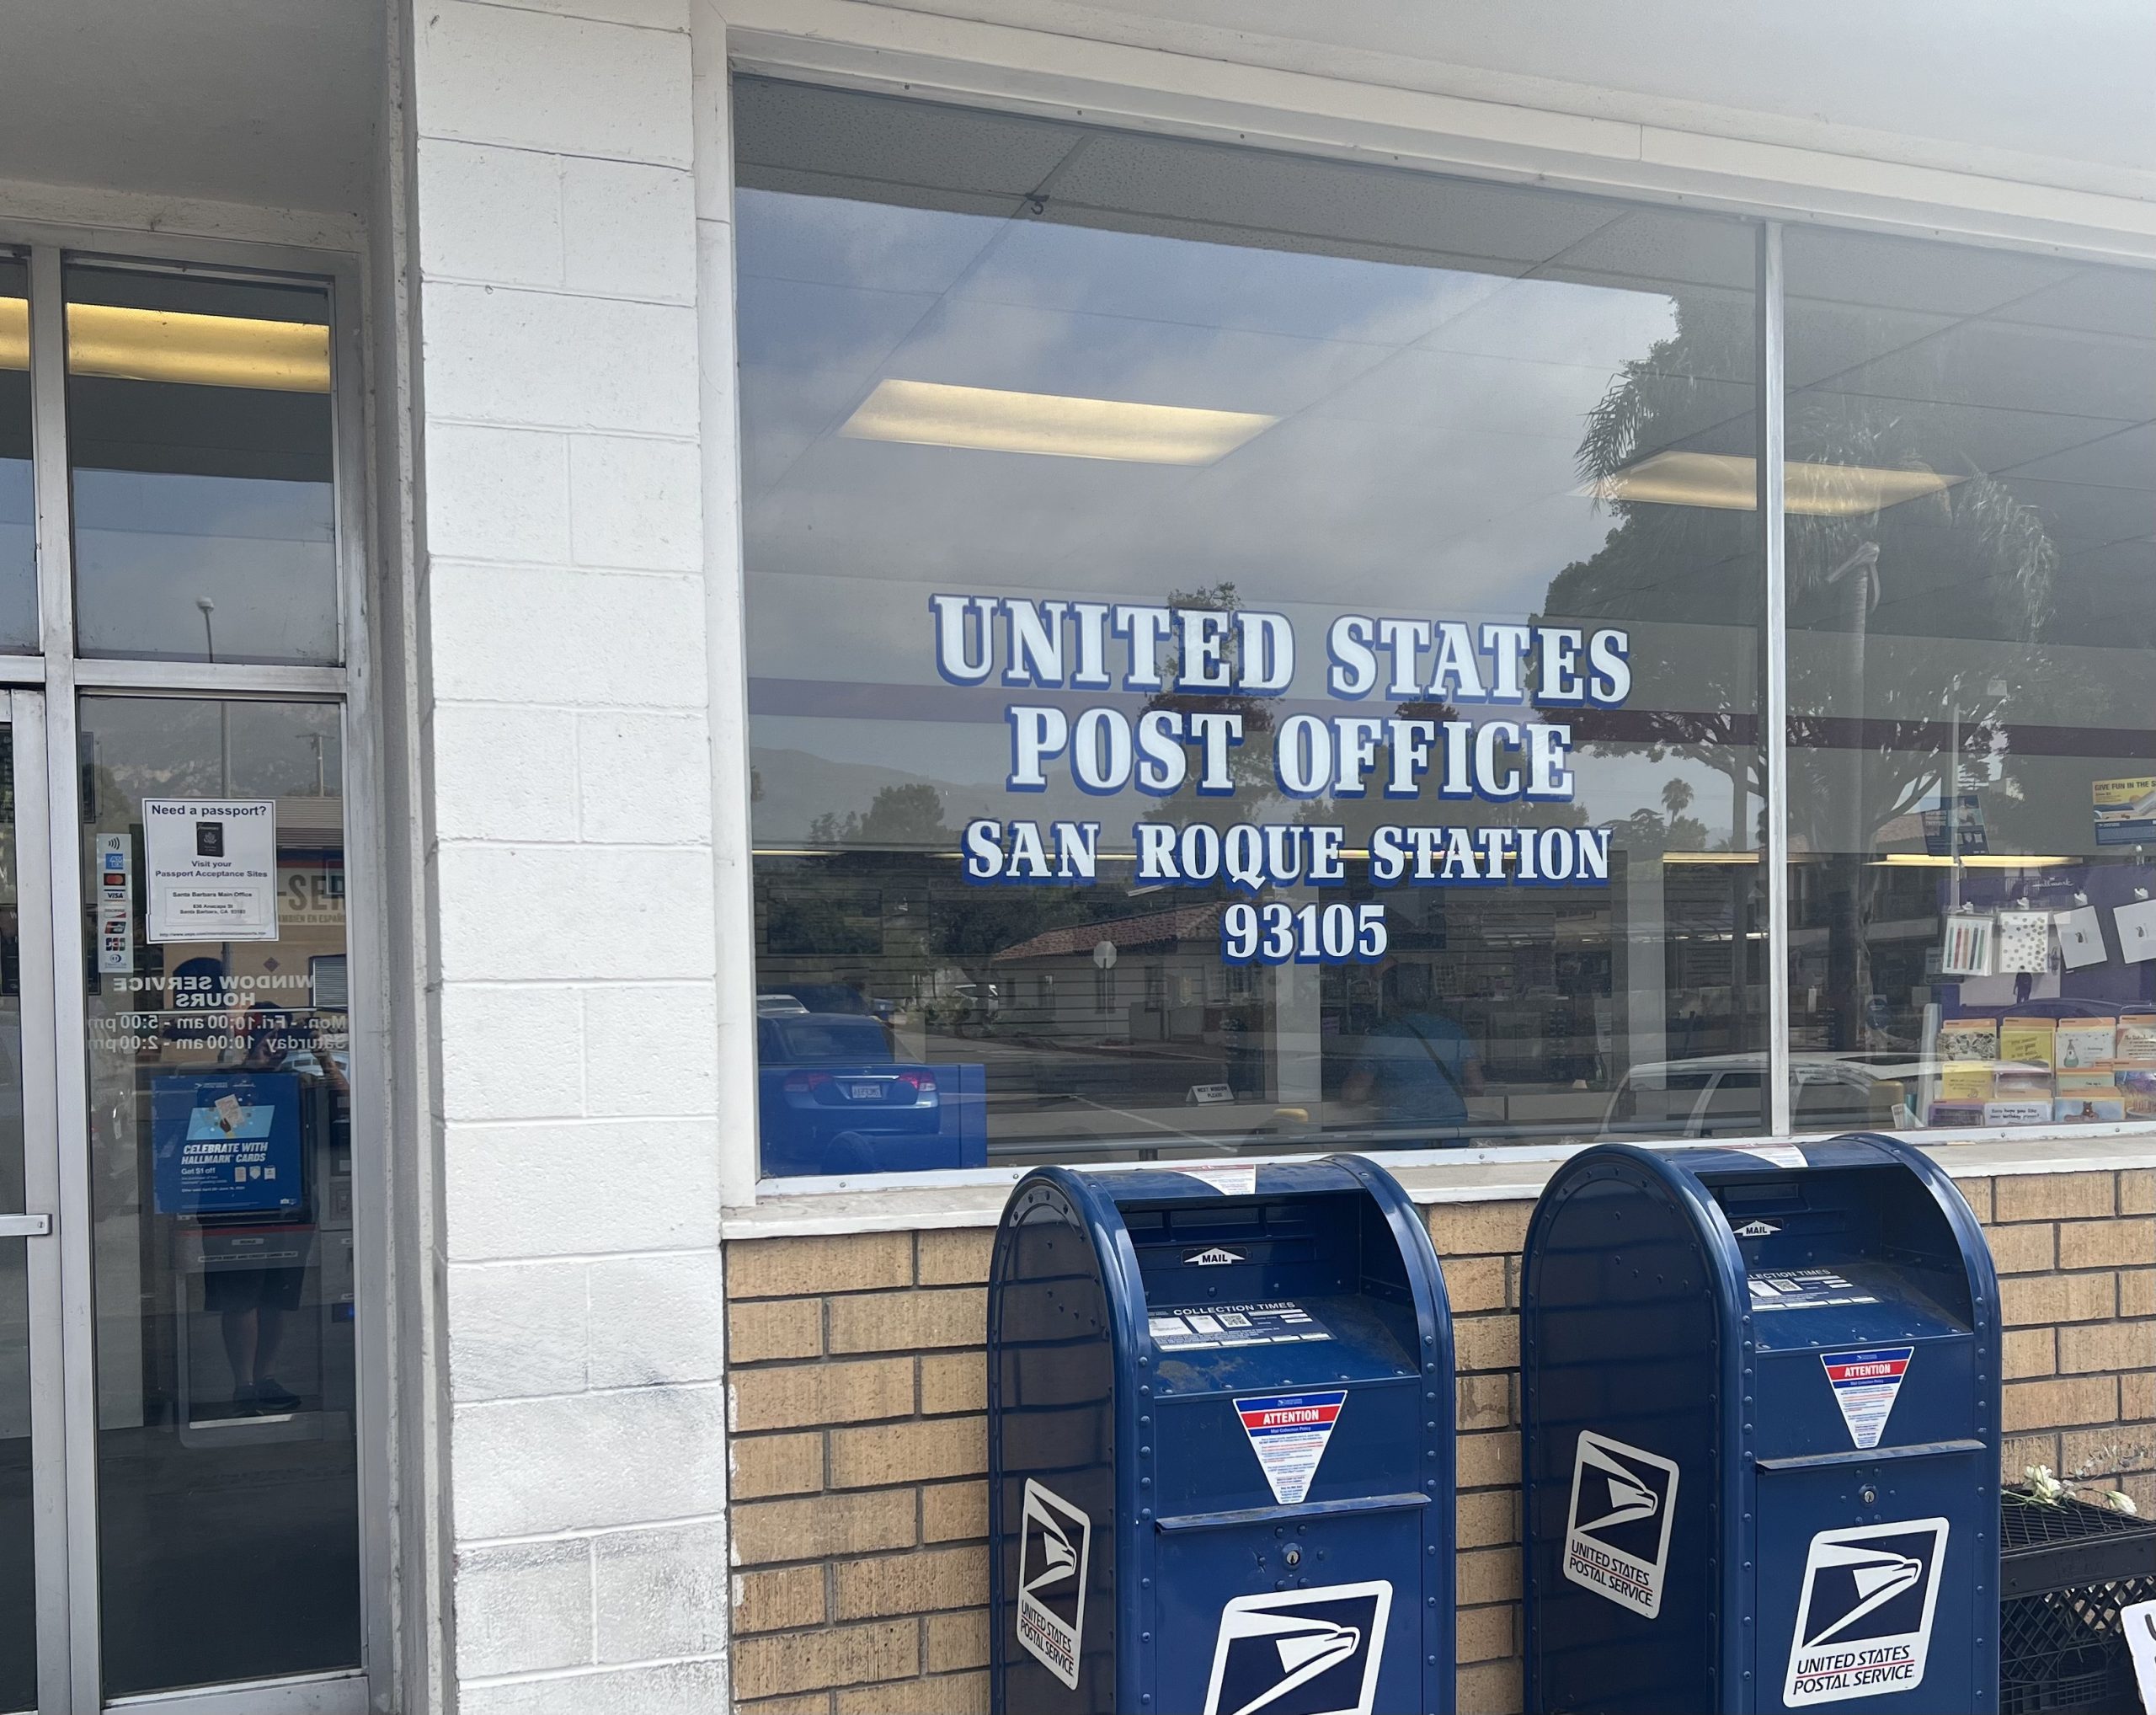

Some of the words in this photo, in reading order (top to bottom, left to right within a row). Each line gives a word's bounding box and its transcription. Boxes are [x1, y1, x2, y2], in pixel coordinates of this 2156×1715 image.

[930, 594, 1295, 697] UNITED
[1327, 614, 1632, 709] STATES
[1007, 705, 1243, 797] POST
[1273, 713, 1575, 801] OFFICE
[152, 804, 185, 815] Need
[189, 807, 197, 815] a
[201, 805, 267, 817] passport?
[212, 862, 232, 870] your
[962, 820, 1100, 886] SAN
[1133, 823, 1346, 898] ROQUE
[1368, 826, 1613, 888] STATION
[2031, 878, 2074, 887] Hallmark
[1221, 903, 1388, 966] 93105
[183, 1143, 240, 1155] CELEBRATE
[241, 1141, 269, 1153] WITH
[235, 1152, 267, 1163] CARDS
[1745, 1226, 1768, 1235] MAIL
[1202, 1254, 1229, 1264] MAIL
[1748, 1270, 1796, 1280] LECTION
[1173, 1305, 1255, 1316] COLLECTION
[1257, 1301, 1296, 1311] TIMES
[1844, 1363, 1891, 1377] ATTENTION
[1263, 1409, 1320, 1425] ATTENTION
[1572, 1539, 1610, 1568] UNITED
[1611, 1559, 1650, 1587] STATES
[1569, 1556, 1607, 1586] POSTAL
[1608, 1578, 1653, 1607] SERVICE
[1022, 1600, 1047, 1632] UNITED
[1046, 1620, 1072, 1654] STATES
[1020, 1618, 1044, 1652] POSTAL
[1044, 1640, 1075, 1677] SERVICE
[1797, 1653, 1855, 1675] UNITED
[1857, 1644, 1910, 1666] STATES
[1793, 1673, 1850, 1696] POSTAL
[1853, 1664, 1915, 1686] SERVICE
